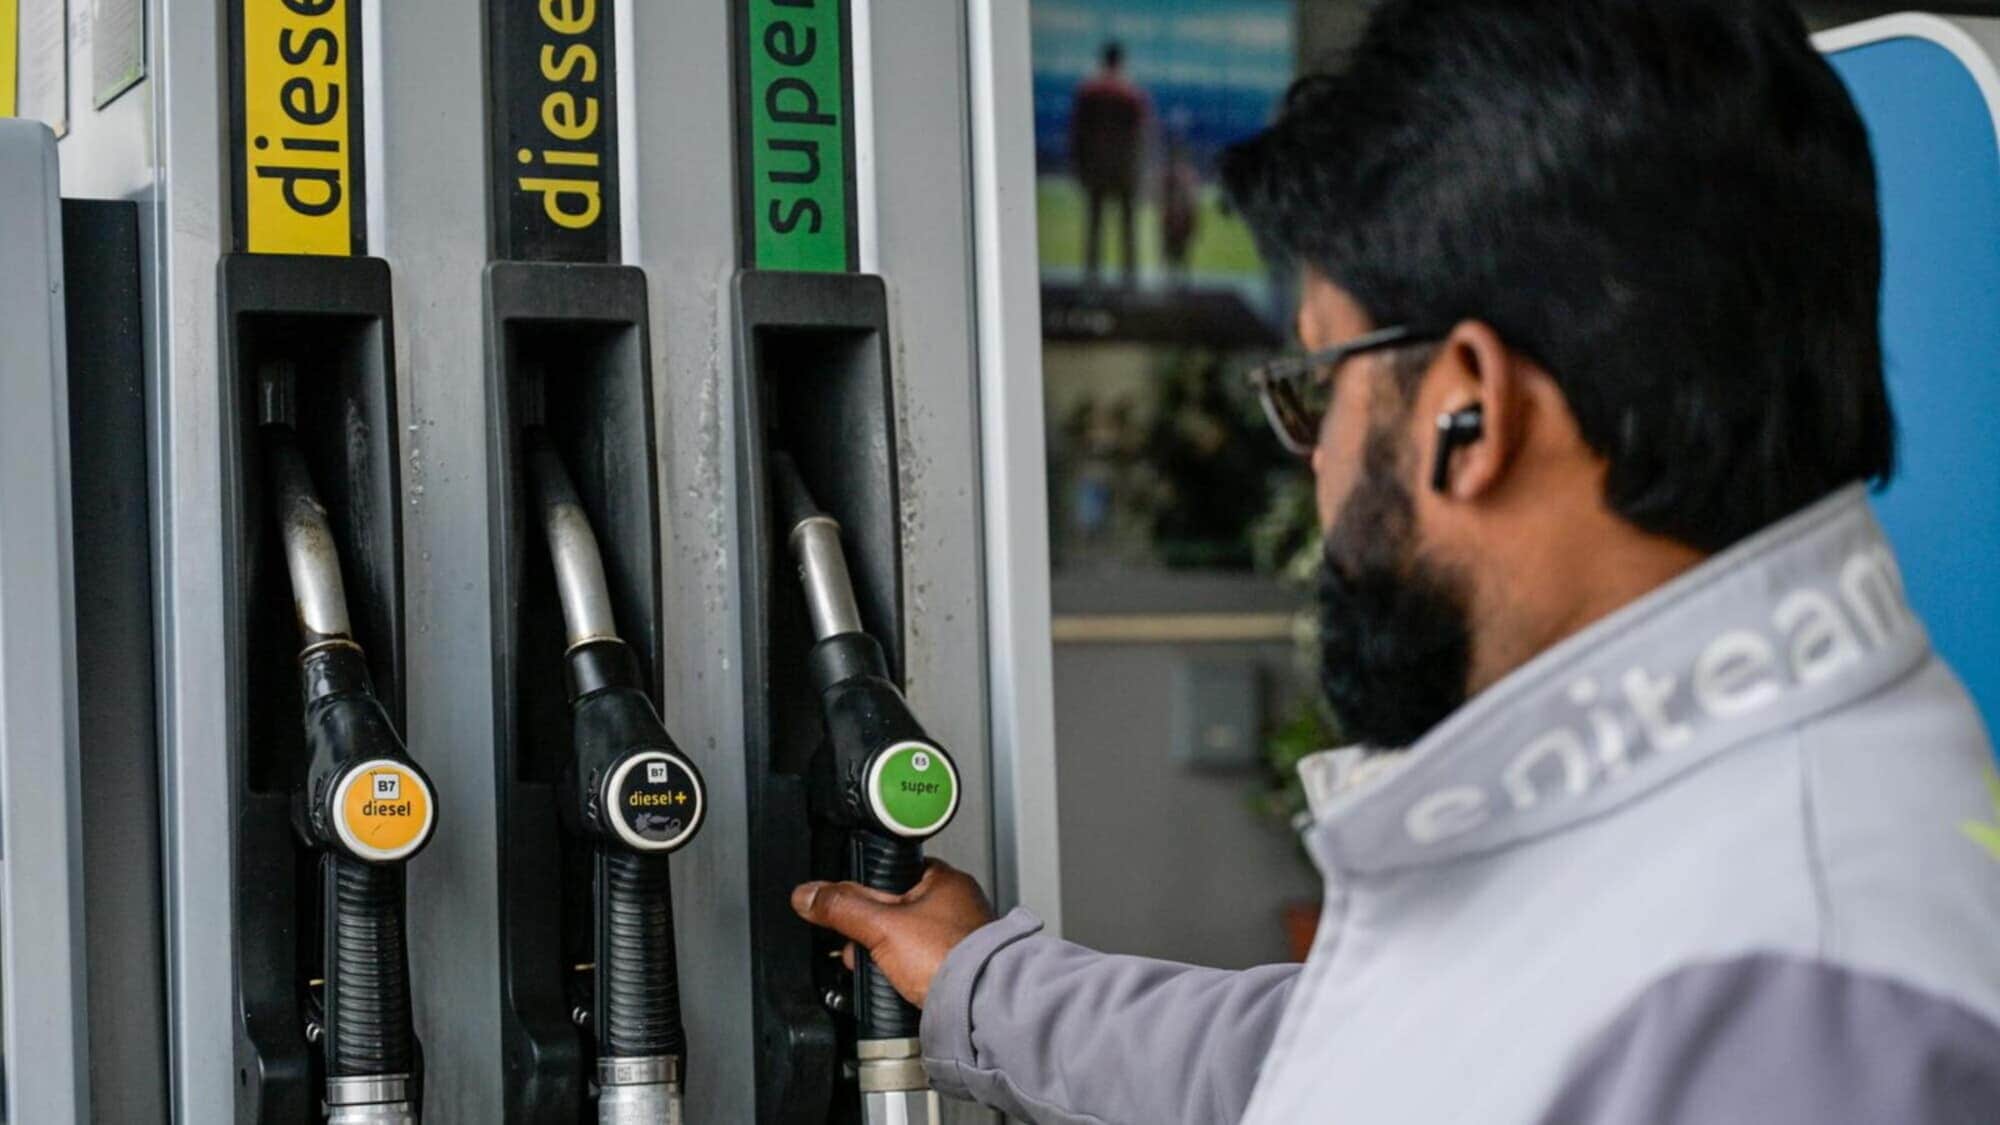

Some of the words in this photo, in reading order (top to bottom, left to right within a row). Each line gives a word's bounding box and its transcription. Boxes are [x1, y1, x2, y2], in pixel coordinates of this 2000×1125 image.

[650, 768, 664, 777] B7
[378, 780, 396, 792] B7
[901, 780, 940, 795] super
[362, 800, 411, 816] diesel
